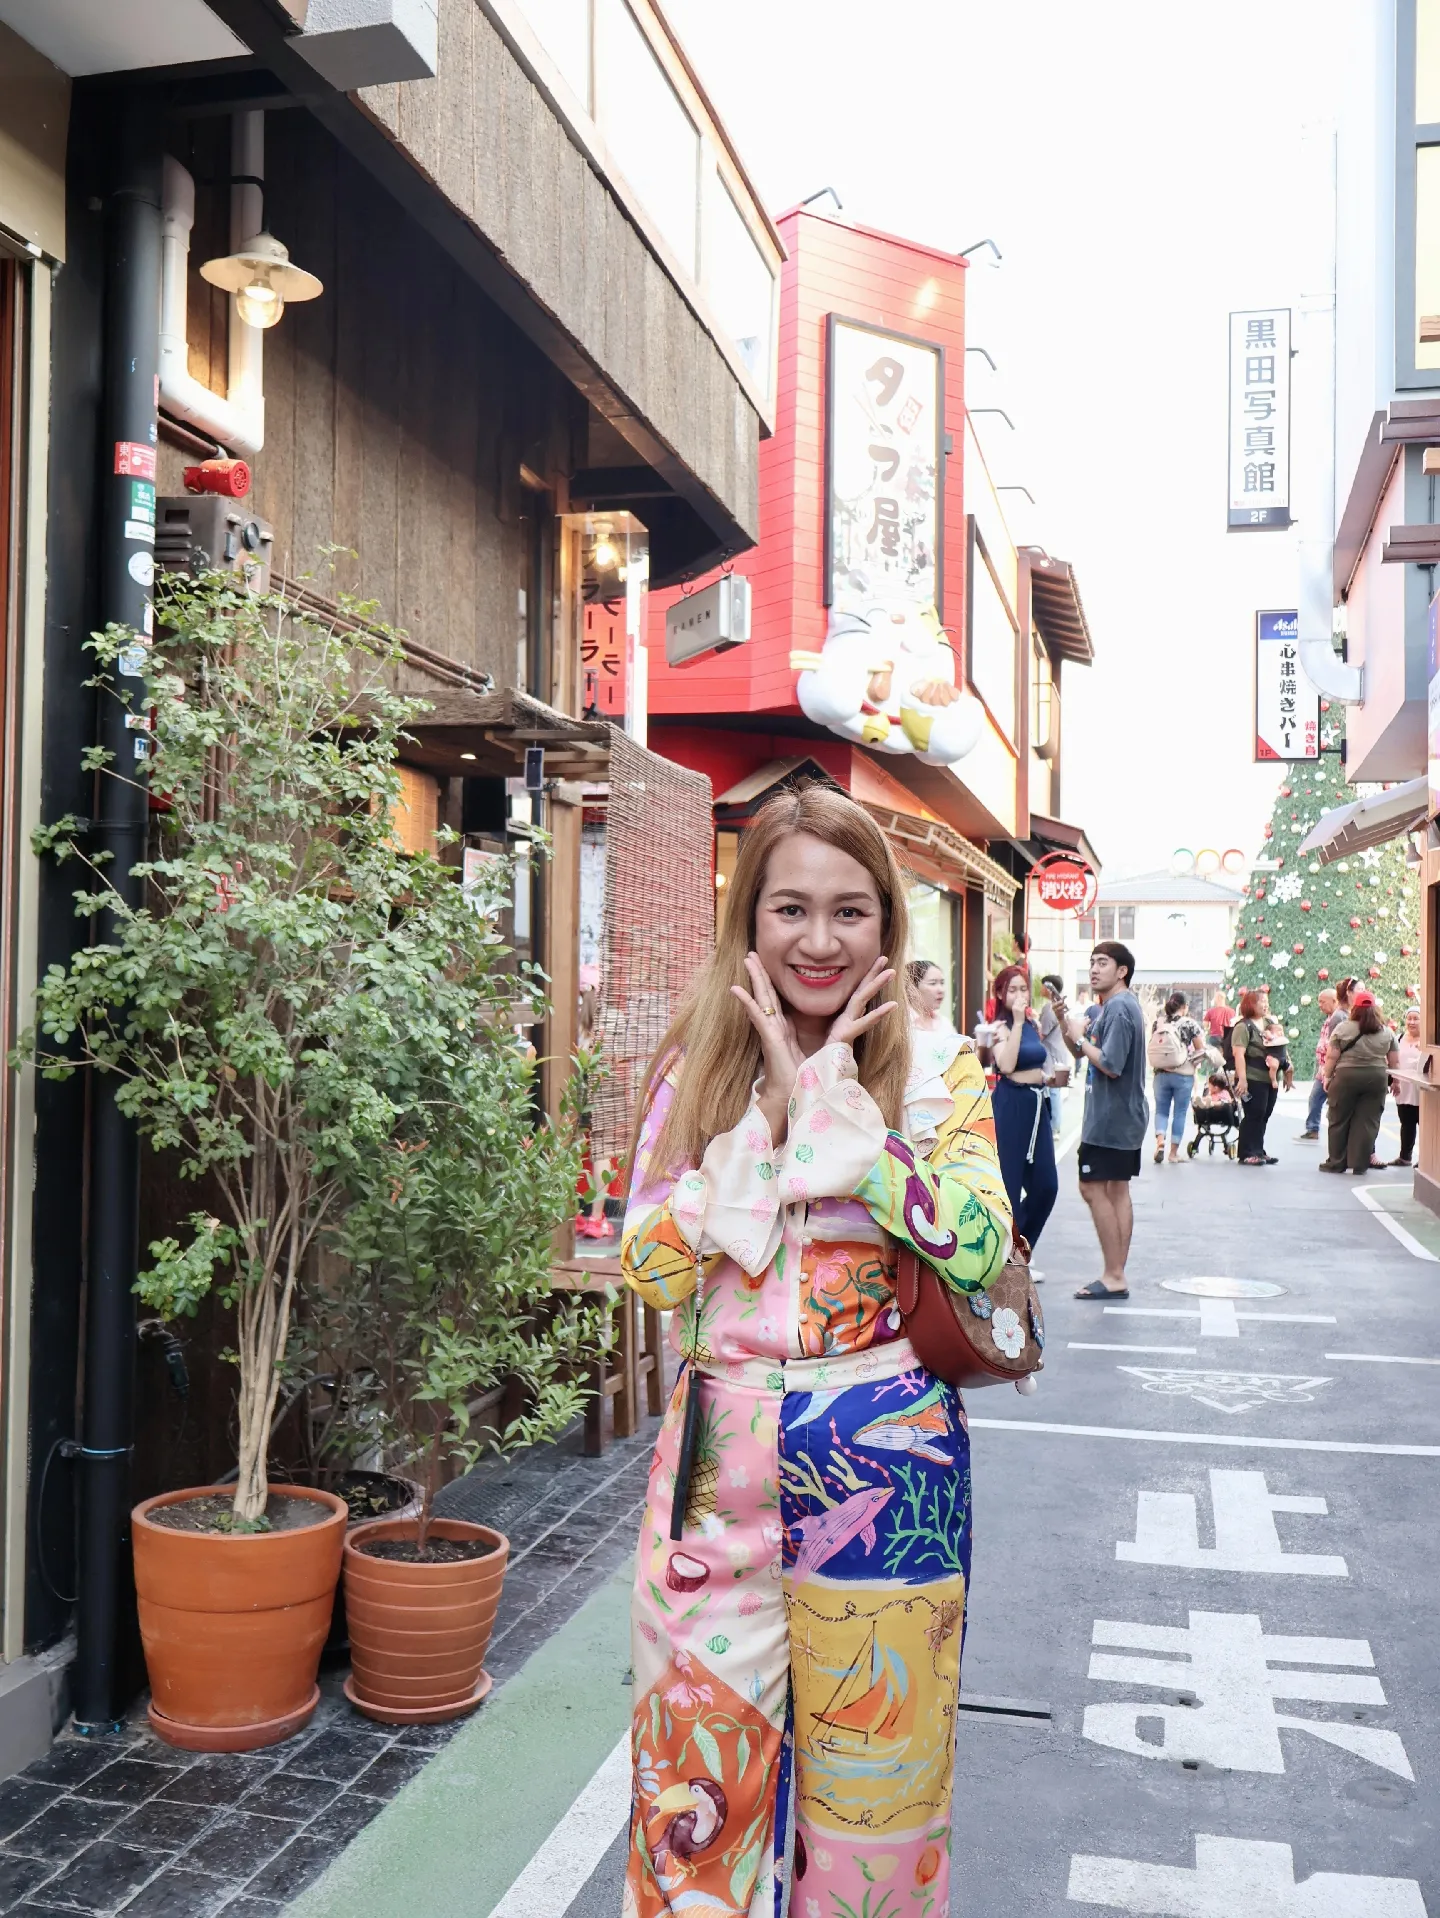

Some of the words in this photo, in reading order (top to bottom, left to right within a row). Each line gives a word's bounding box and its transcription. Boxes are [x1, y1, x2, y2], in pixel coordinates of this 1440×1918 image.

[1243, 318, 1276, 493] 黒田写真館
[1250, 510, 1267, 523] 2F
[673, 609, 711, 636] RAMEN
[1279, 643, 1297, 749] 心串焼きバー
[1259, 749, 1272, 757] 1F
[1041, 881, 1085, 900] 消火栓
